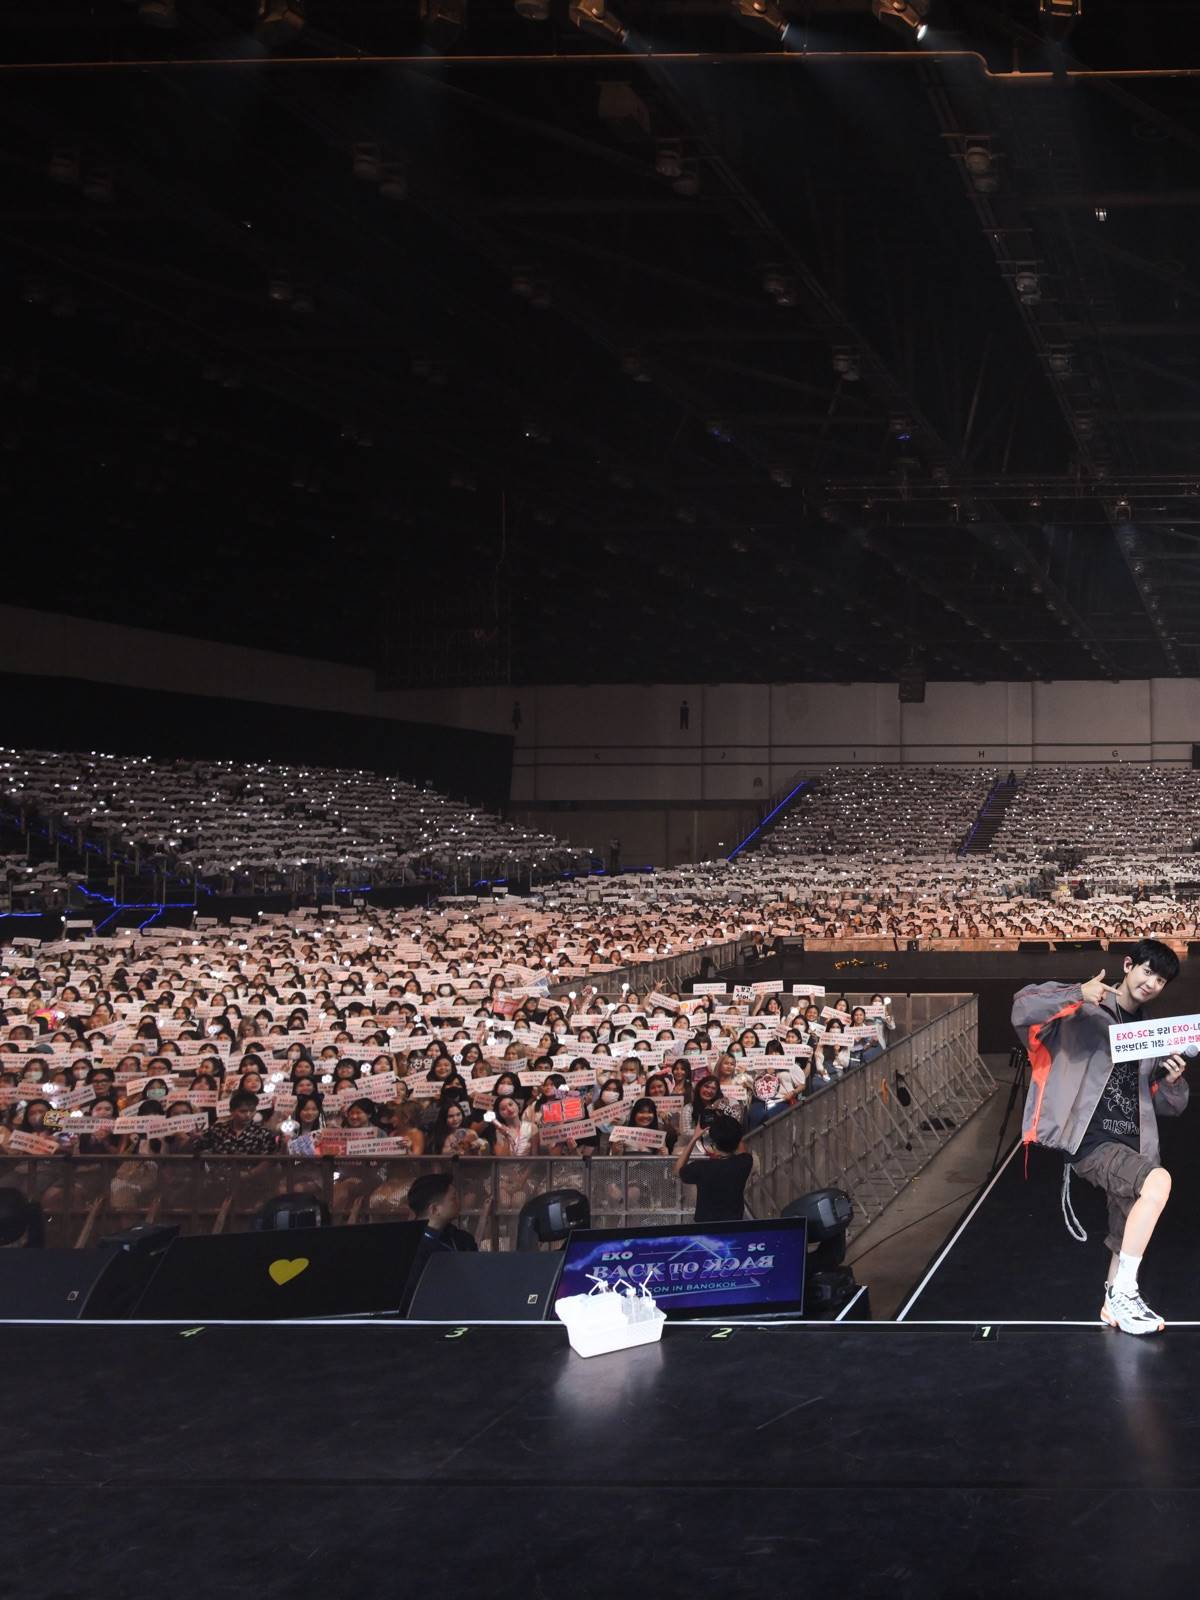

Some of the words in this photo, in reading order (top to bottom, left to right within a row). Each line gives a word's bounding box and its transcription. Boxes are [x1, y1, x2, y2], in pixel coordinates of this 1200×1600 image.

[978, 750, 985, 759] H
[1111, 749, 1119, 758] G
[1116, 1029, 1155, 1041] EXO-SC는
[1156, 1027, 1171, 1035] 우리
[1115, 1041, 1149, 1053] 무엇보다도
[1151, 1039, 1165, 1048] 가장
[1167, 1036, 1187, 1046] 소중한
[601, 1251, 633, 1261] EXO
[748, 1243, 766, 1252] SC
[592, 1262, 667, 1280] BACK
[670, 1263, 700, 1275] TO
[686, 1282, 737, 1291] BANGKOK
[445, 1327, 469, 1338] 3
[711, 1327, 733, 1338] 2
[981, 1326, 992, 1338] 1
